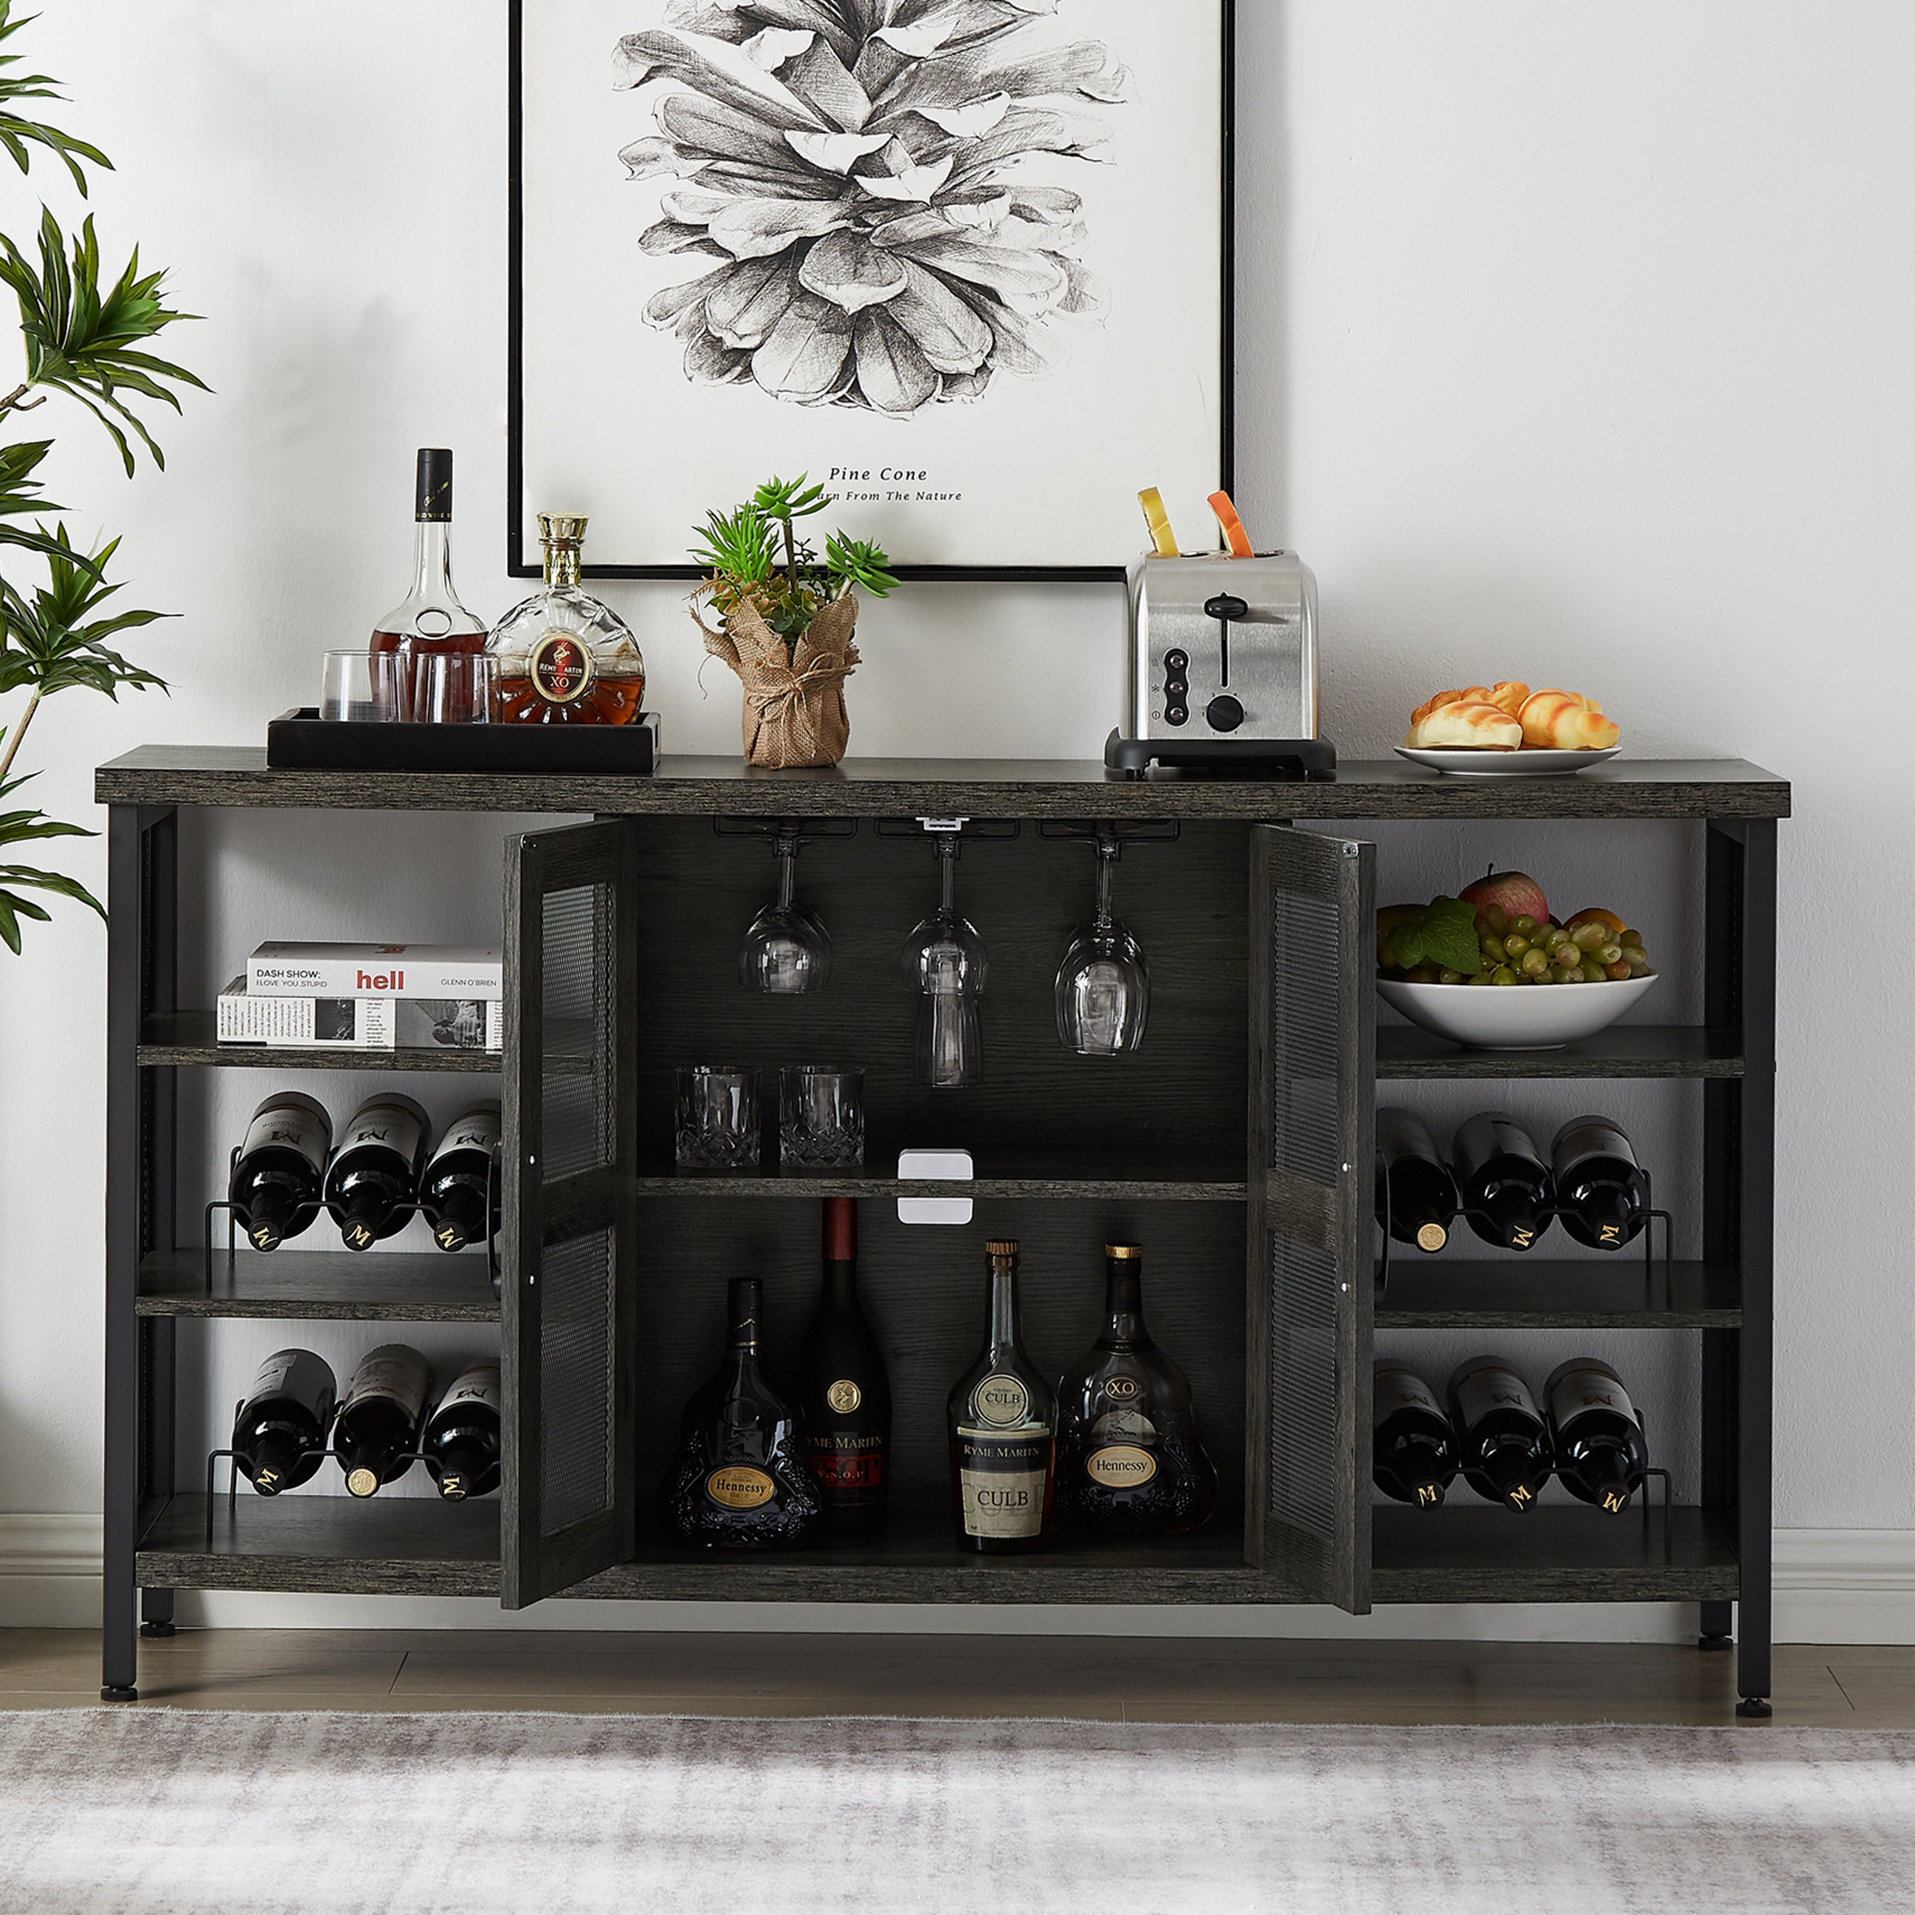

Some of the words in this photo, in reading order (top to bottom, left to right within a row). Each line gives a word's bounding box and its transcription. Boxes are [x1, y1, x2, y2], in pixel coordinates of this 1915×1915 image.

[829, 467, 871, 481] Pine
[880, 467, 928, 481] Cone
[803, 491, 840, 501] arn
[846, 491, 880, 501] From
[886, 491, 910, 501] The
[915, 491, 962, 501] Nature
[550, 676, 570, 688] XO
[256, 969, 285, 978] DASH
[286, 969, 321, 979] SHOW:
[356, 970, 404, 990] hell
[300, 980, 328, 988] STUPID
[440, 978, 467, 986] GLENN
[467, 979, 497, 987] O'BRIEN
[985, 1391, 1020, 1404] CULB
[806, 1436, 833, 1449] YME
[1096, 1459, 1148, 1473] Hennessy
[716, 1478, 767, 1497] Hennessy
[977, 1490, 1029, 1507] CULB
